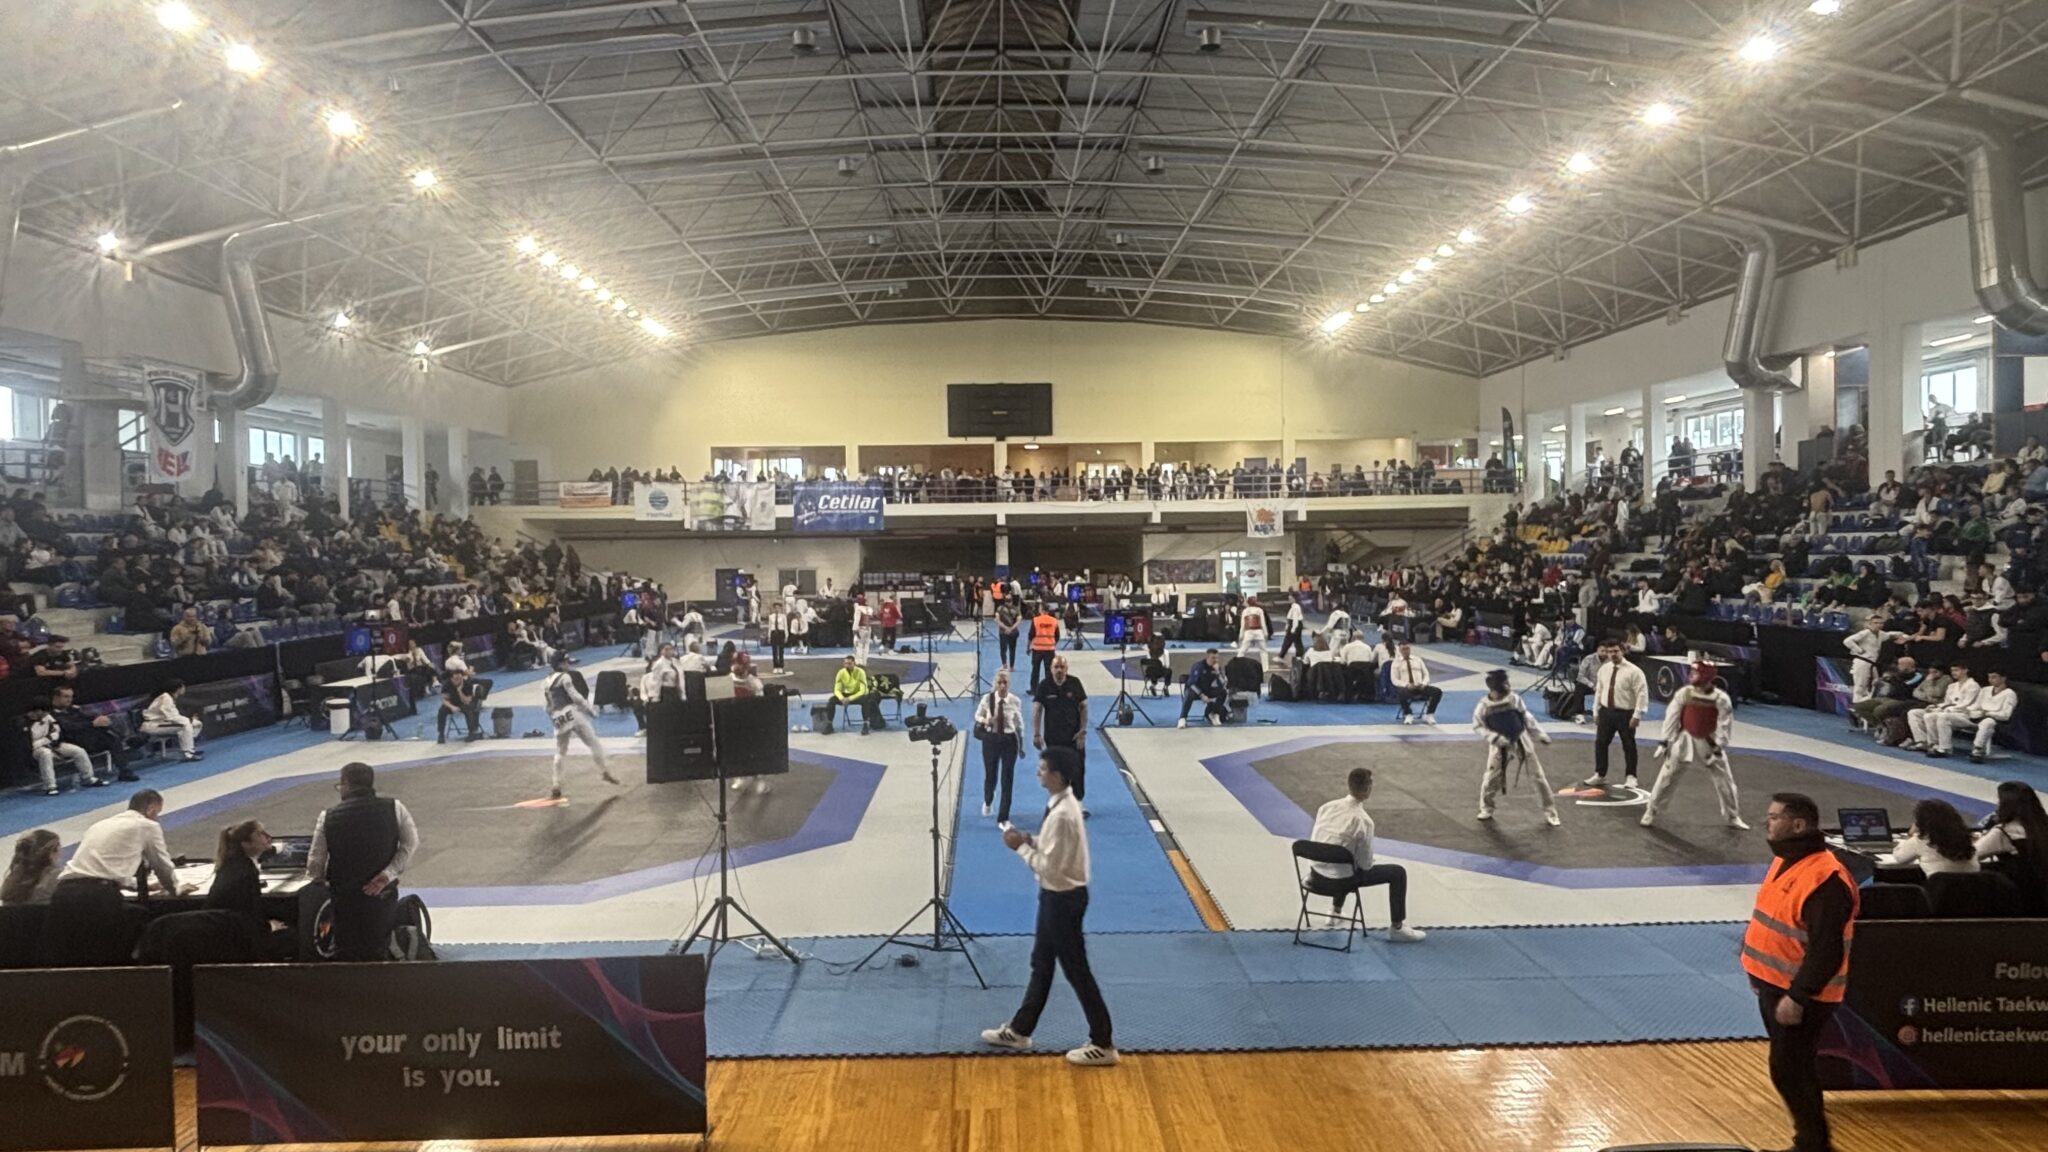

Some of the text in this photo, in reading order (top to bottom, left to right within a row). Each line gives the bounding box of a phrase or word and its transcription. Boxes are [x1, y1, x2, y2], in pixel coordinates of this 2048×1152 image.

[818, 494, 880, 510] Cetilar
[1113, 622, 1121, 634] 0
[1136, 622, 1144, 633] 0
[388, 633, 397, 645] 0
[1923, 997, 1993, 1013] Hellenic
[341, 1025, 562, 1060] your only limit
[403, 1066, 500, 1094] is you.
